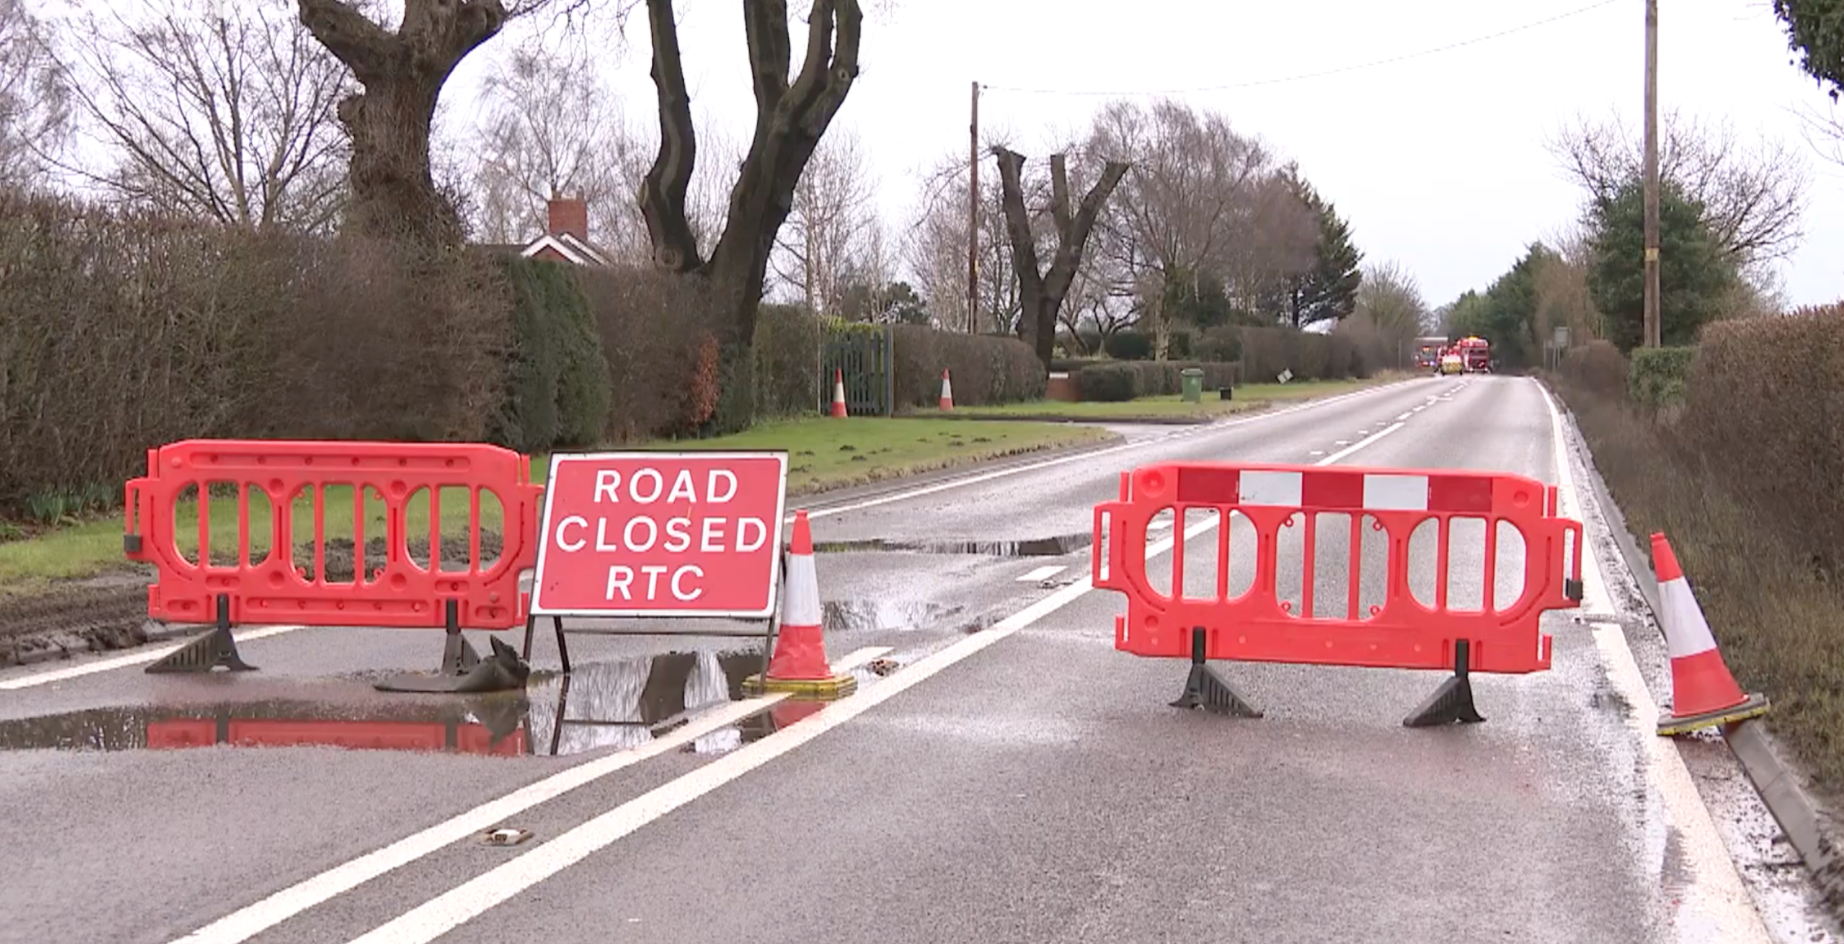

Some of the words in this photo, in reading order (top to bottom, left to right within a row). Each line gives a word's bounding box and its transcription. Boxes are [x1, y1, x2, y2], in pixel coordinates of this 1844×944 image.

[593, 468, 738, 503] ROAD
[555, 515, 767, 552] CLOSED
[605, 564, 704, 600] RTC
